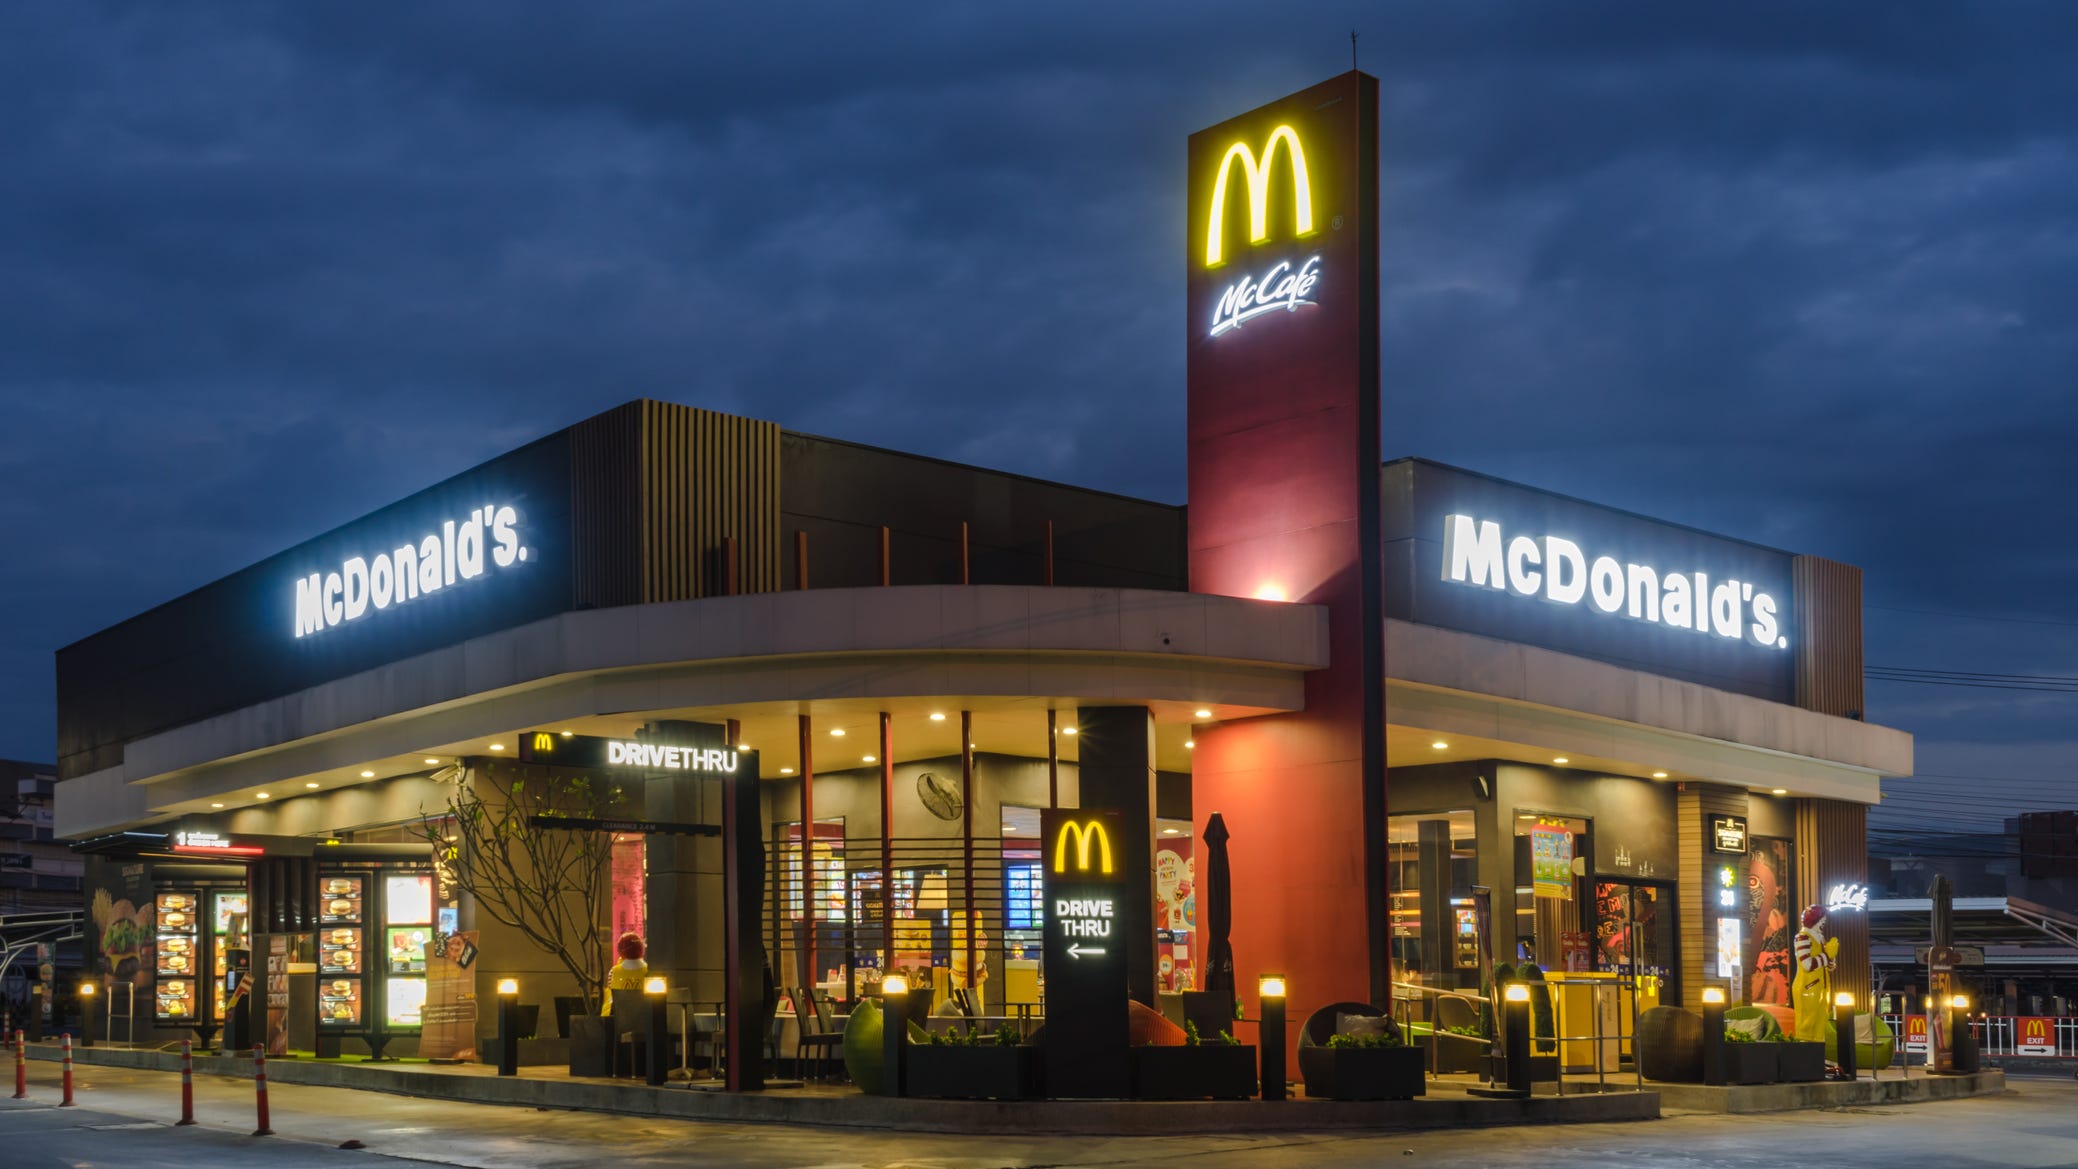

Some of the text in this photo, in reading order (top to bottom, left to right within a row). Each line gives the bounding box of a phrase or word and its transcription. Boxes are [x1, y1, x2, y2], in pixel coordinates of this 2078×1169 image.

[1211, 255, 1320, 336] McCafé
[1160, 870, 1177, 880] PARTY
[1056, 900, 1114, 917] DRIVE
[1061, 919, 1110, 937] THRU
[1909, 1034, 1926, 1042] EXIT
[2026, 1037, 2045, 1045] EXIT
